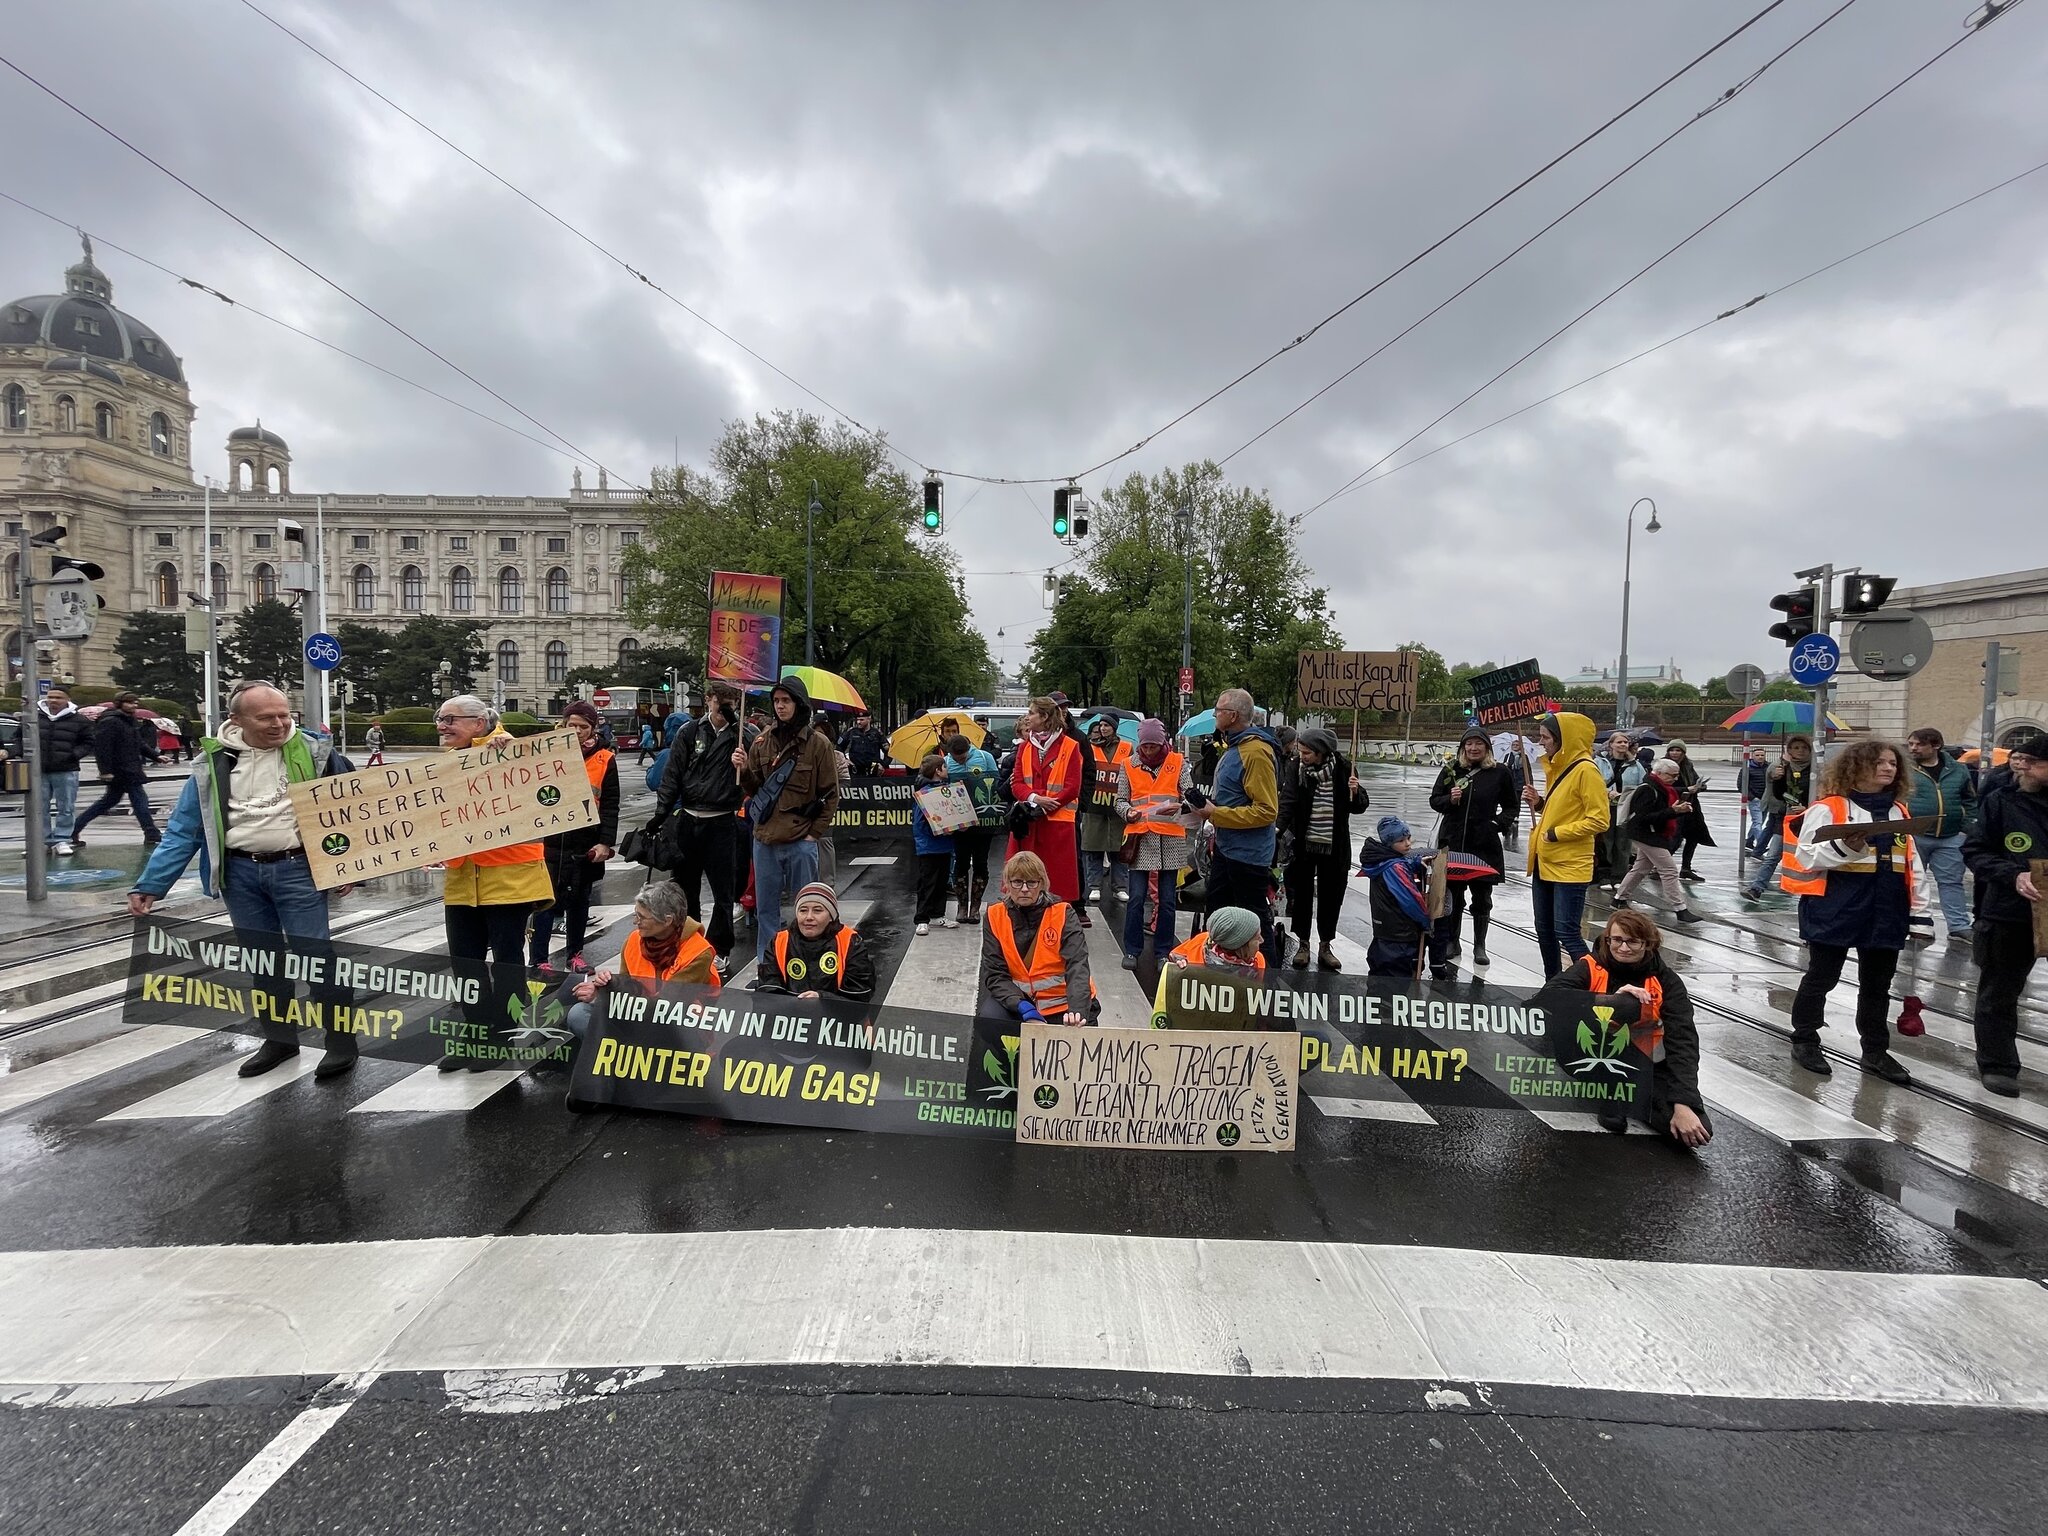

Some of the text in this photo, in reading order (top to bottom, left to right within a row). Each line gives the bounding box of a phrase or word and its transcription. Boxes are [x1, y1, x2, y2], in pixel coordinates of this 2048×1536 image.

[715, 579, 771, 609] Mutter
[717, 617, 760, 633] ERDE
[1299, 652, 1413, 691] Mutti ist kaputti
[1299, 680, 1412, 712] Vati isst Gelati
[1478, 679, 1541, 707] IST DAS NEUE
[1480, 694, 1547, 725] VERLEUGNEN
[309, 778, 363, 805] FÜR
[386, 763, 438, 788] DIE
[458, 735, 575, 770] ZUKUNFT
[1096, 770, 1106, 781] IR
[318, 786, 445, 828] UNSERER
[466, 759, 567, 797] KINDER
[839, 787, 869, 800] UEN
[365, 794, 522, 846] UND ENKEL
[335, 841, 439, 876] RUNTER
[464, 826, 511, 844] VOM
[147, 925, 481, 1005] UND WENN DIE REGIERUNG
[142, 973, 403, 1041] KEINEN PLAN HAT?
[1181, 978, 1545, 1037] UND WENN DIE REGIERUNG
[429, 1016, 489, 1041] LETZTE
[607, 991, 965, 1064] WIR RASEN IN DIE KLIMAHÖLLE.
[444, 1039, 572, 1063] GENERATION.AT
[1031, 1037, 1269, 1087] WIR MAMIS TRAGEN
[1301, 1036, 1468, 1082] PLAN HAT?
[1495, 1052, 1556, 1074] LETZTE
[592, 1037, 881, 1106] RUNTER VOM GAS!
[903, 1075, 967, 1101] LETZTE
[1509, 1075, 1637, 1103] GENERATION.AT
[917, 1101, 1017, 1128] GENERATIO
[1073, 1083, 1252, 1121] VERANTWORTUNG
[1260, 1054, 1290, 1141] GENERATION
[1086, 1118, 1121, 1143] HERR
[1127, 1119, 1208, 1145] NEHAMMER
[1250, 1092, 1271, 1145] LETZTE
